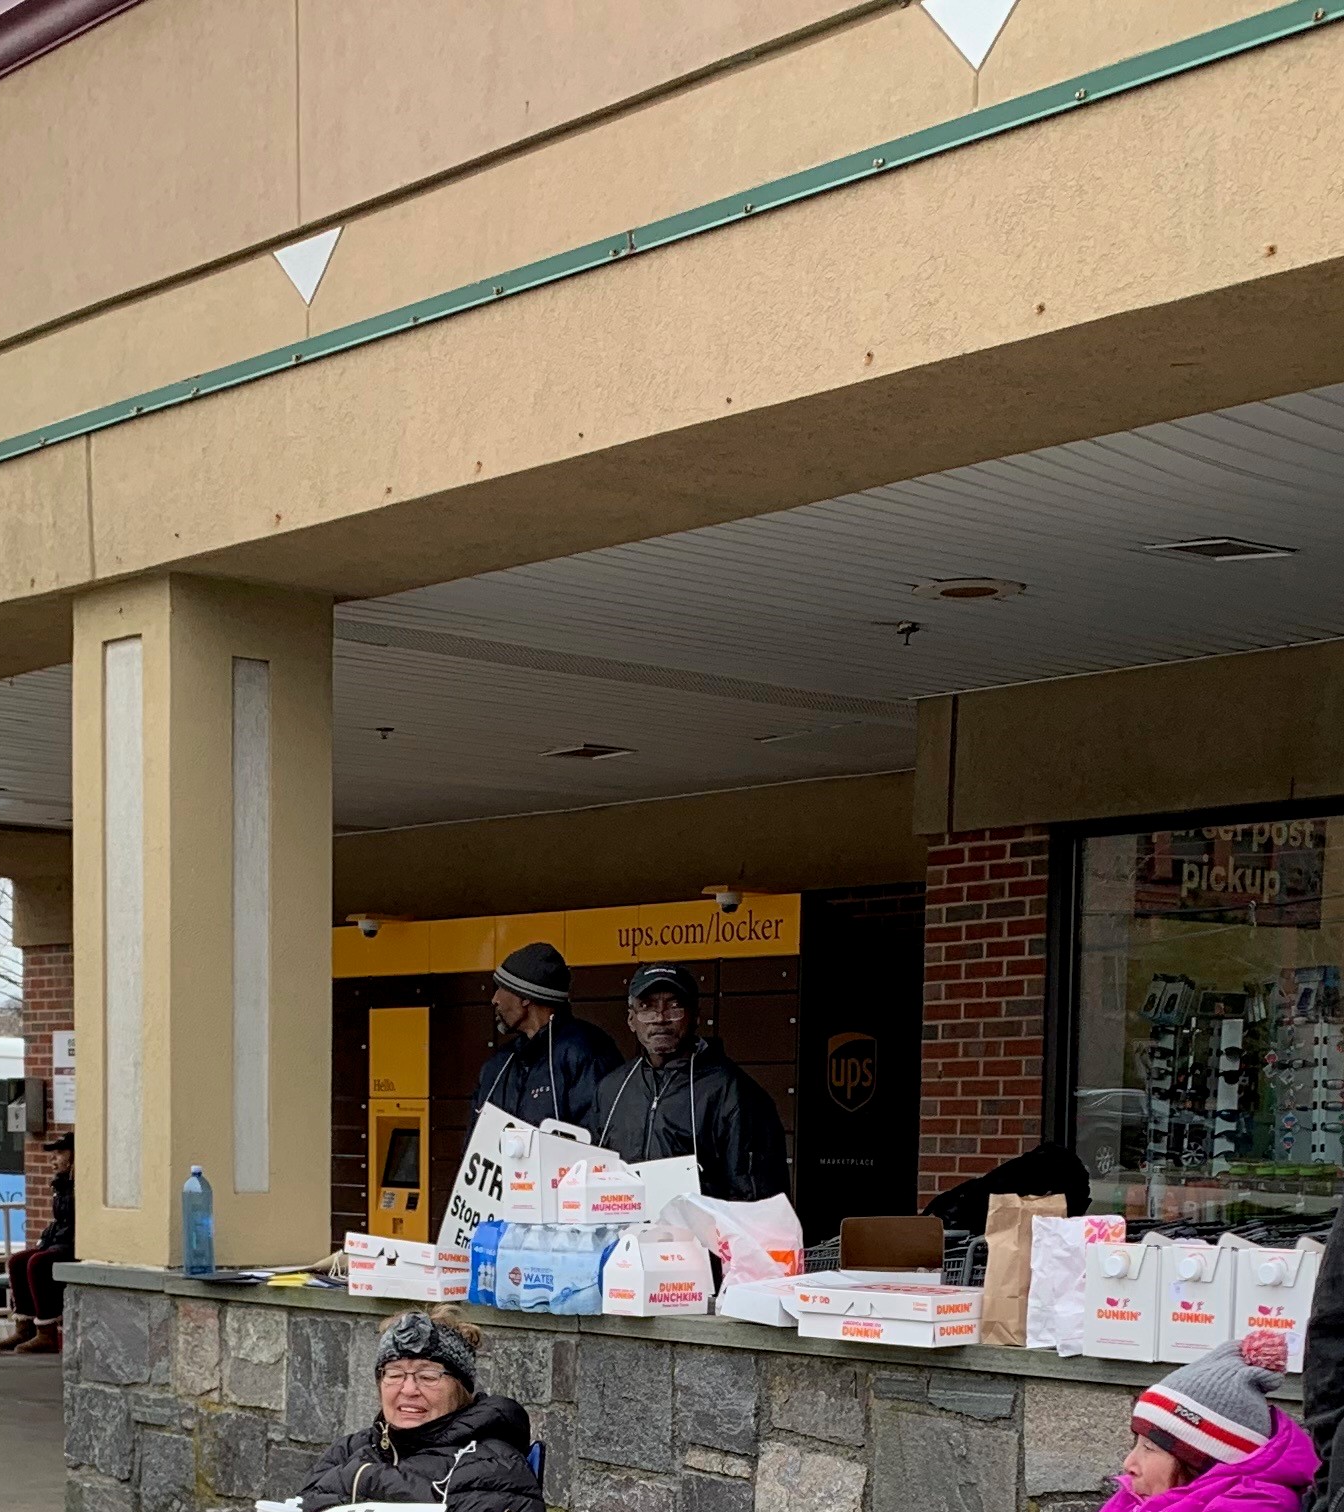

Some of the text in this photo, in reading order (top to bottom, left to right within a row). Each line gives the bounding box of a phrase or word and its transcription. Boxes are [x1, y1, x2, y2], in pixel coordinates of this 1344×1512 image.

[1181, 854, 1281, 904] pickup
[618, 910, 784, 956] ups.com/locker
[832, 1058, 873, 1099] ups
[373, 1079, 396, 1092] Hello.
[820, 1158, 874, 1166] MARKETPLACE
[464, 1152, 503, 1201] STR
[591, 1202, 641, 1211] MUNCHKINS
[523, 1273, 554, 1285] WATER
[443, 1286, 467, 1295] DUNK
[659, 1282, 695, 1292] DUNKIN'
[648, 1292, 703, 1303] MUNCHKINS
[936, 1302, 972, 1314] DUNKIN'
[1097, 1309, 1141, 1321] DUNKIN'
[1172, 1312, 1215, 1324] DUNKIN'
[1248, 1316, 1296, 1329] DUNKIN'
[842, 1326, 883, 1339] DUNKIN'
[939, 1323, 976, 1336] DUNKIN'
